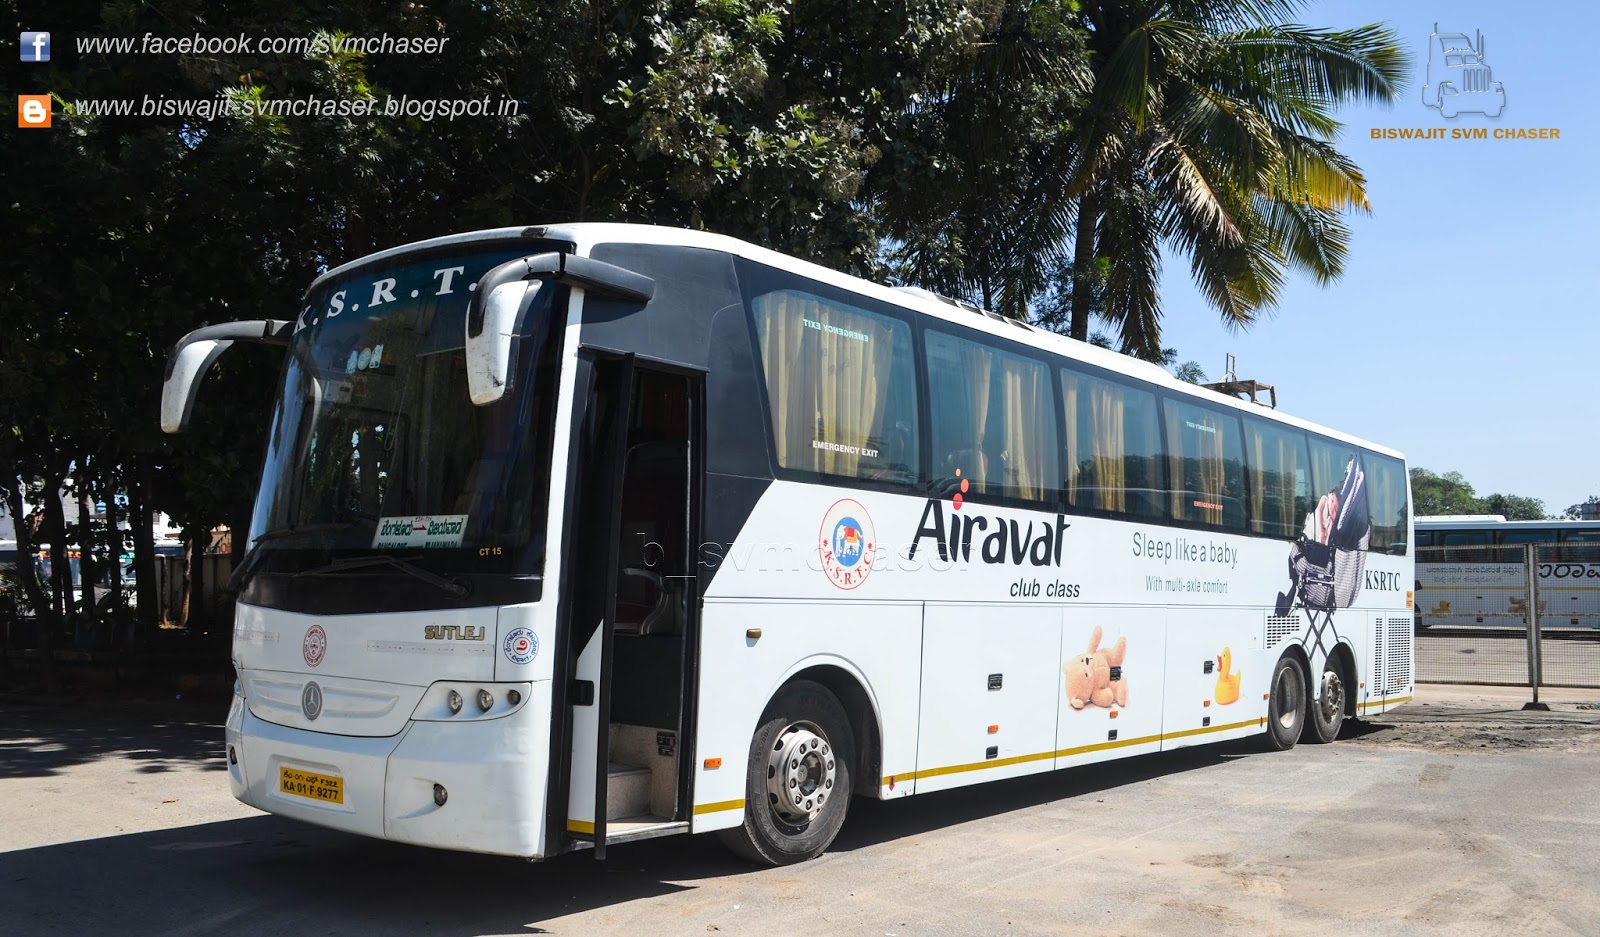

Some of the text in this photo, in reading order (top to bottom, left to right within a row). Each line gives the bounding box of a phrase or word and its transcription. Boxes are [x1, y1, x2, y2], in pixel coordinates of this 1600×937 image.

[292, 265, 478, 336] K.S.R.T.
[812, 440, 879, 458] EMERGENCY EXIT
[908, 490, 1071, 568] Airavat
[479, 547, 502, 556] CT 15
[1132, 531, 1238, 569] Sleep like a baby.
[1009, 577, 1081, 598] club class
[1145, 575, 1228, 594] With multi-axle comfort
[1365, 569, 1401, 592] KSRTC
[424, 625, 486, 641] SUTLEJ
[283, 780, 338, 800] KA 01 F 9277
